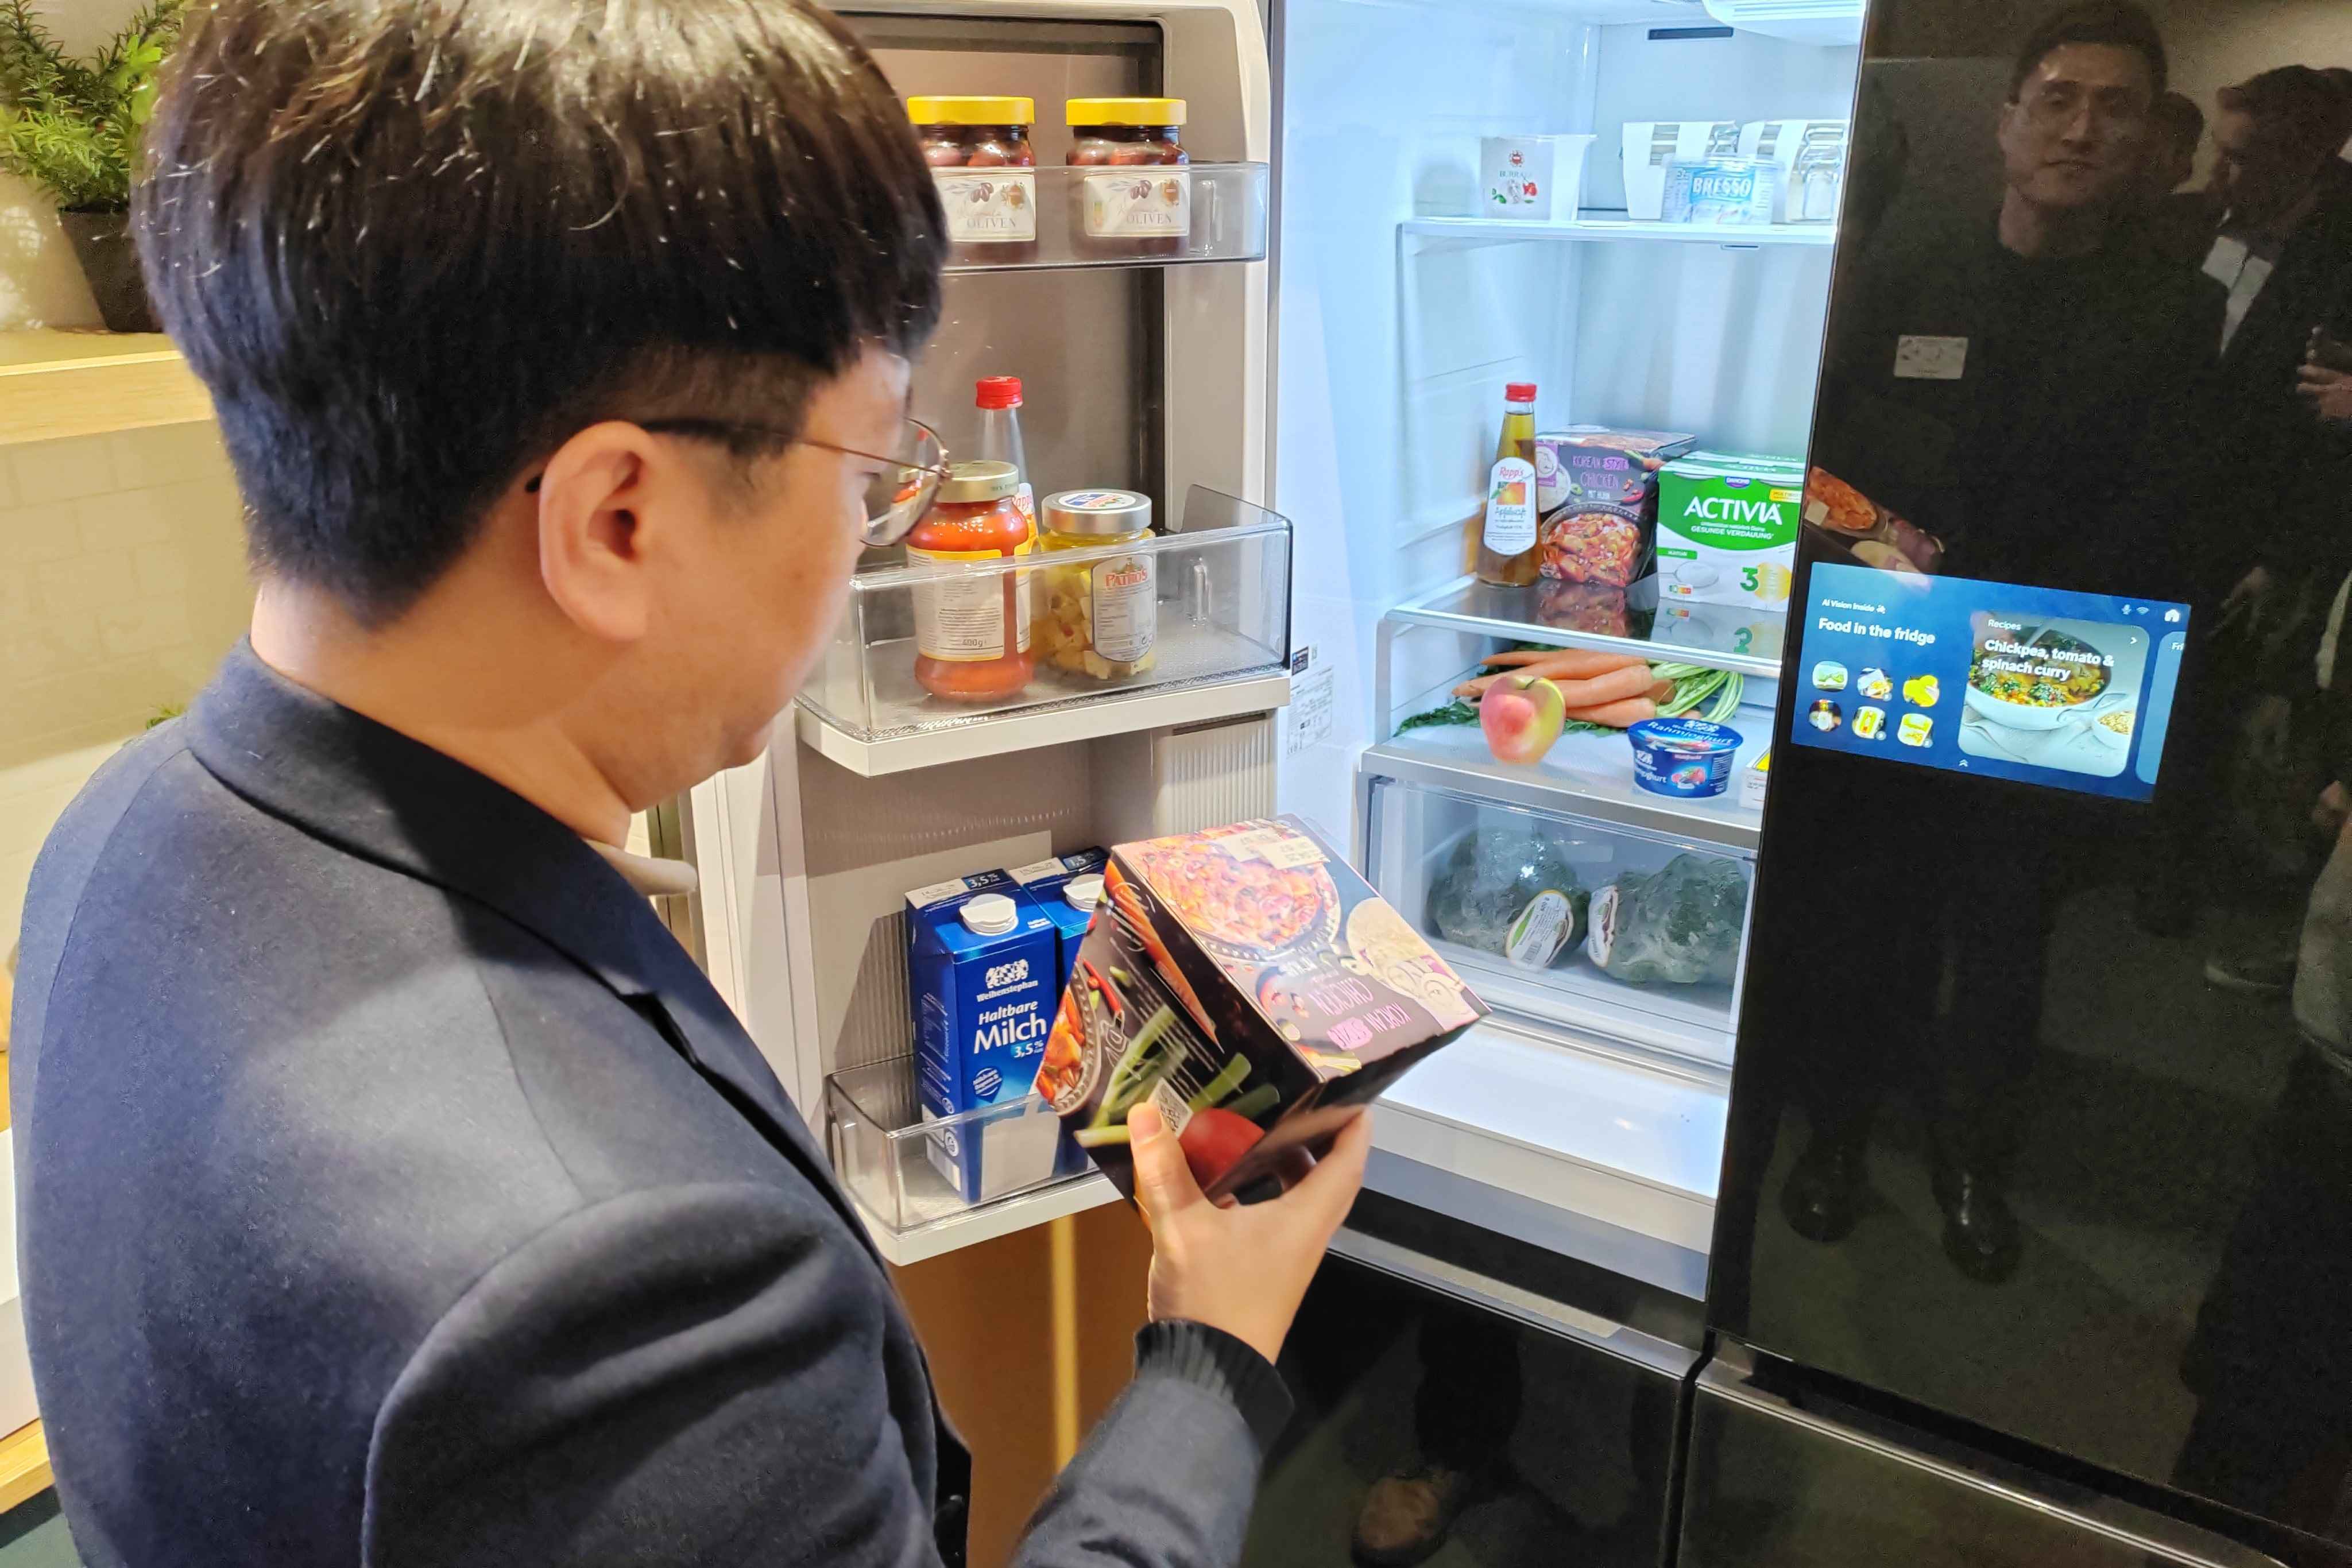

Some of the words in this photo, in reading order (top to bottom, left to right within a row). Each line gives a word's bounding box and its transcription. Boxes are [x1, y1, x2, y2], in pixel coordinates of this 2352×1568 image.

[1692, 177, 1753, 198] BRESSO
[966, 217, 1016, 229] OLIVEN
[1126, 213, 1172, 224] OLIVEN
[1683, 495, 1782, 525] ACTIVIA
[1690, 525, 1725, 536] GESUNDE
[1739, 567, 1759, 592] 3
[1831, 600, 1852, 610] Vision
[1852, 602, 1875, 613] Inside
[1818, 617, 1852, 633] Food
[1853, 621, 1867, 636] in
[1869, 624, 1892, 638] the
[1894, 627, 1936, 646] fridge
[1987, 618, 2022, 631] Recipes
[1984, 639, 2050, 660] Chickpea,
[2052, 648, 2101, 667] tomato
[2102, 655, 2115, 667] &
[1982, 657, 2033, 675] spinach
[2033, 666, 2072, 682] curry
[968, 875, 989, 888] 3,5
[976, 980, 1039, 1002] Weihenstephan
[978, 1000, 1039, 1025] Haltbare
[973, 1012, 1047, 1054] Milch
[1013, 1042, 1034, 1058] 3,5
